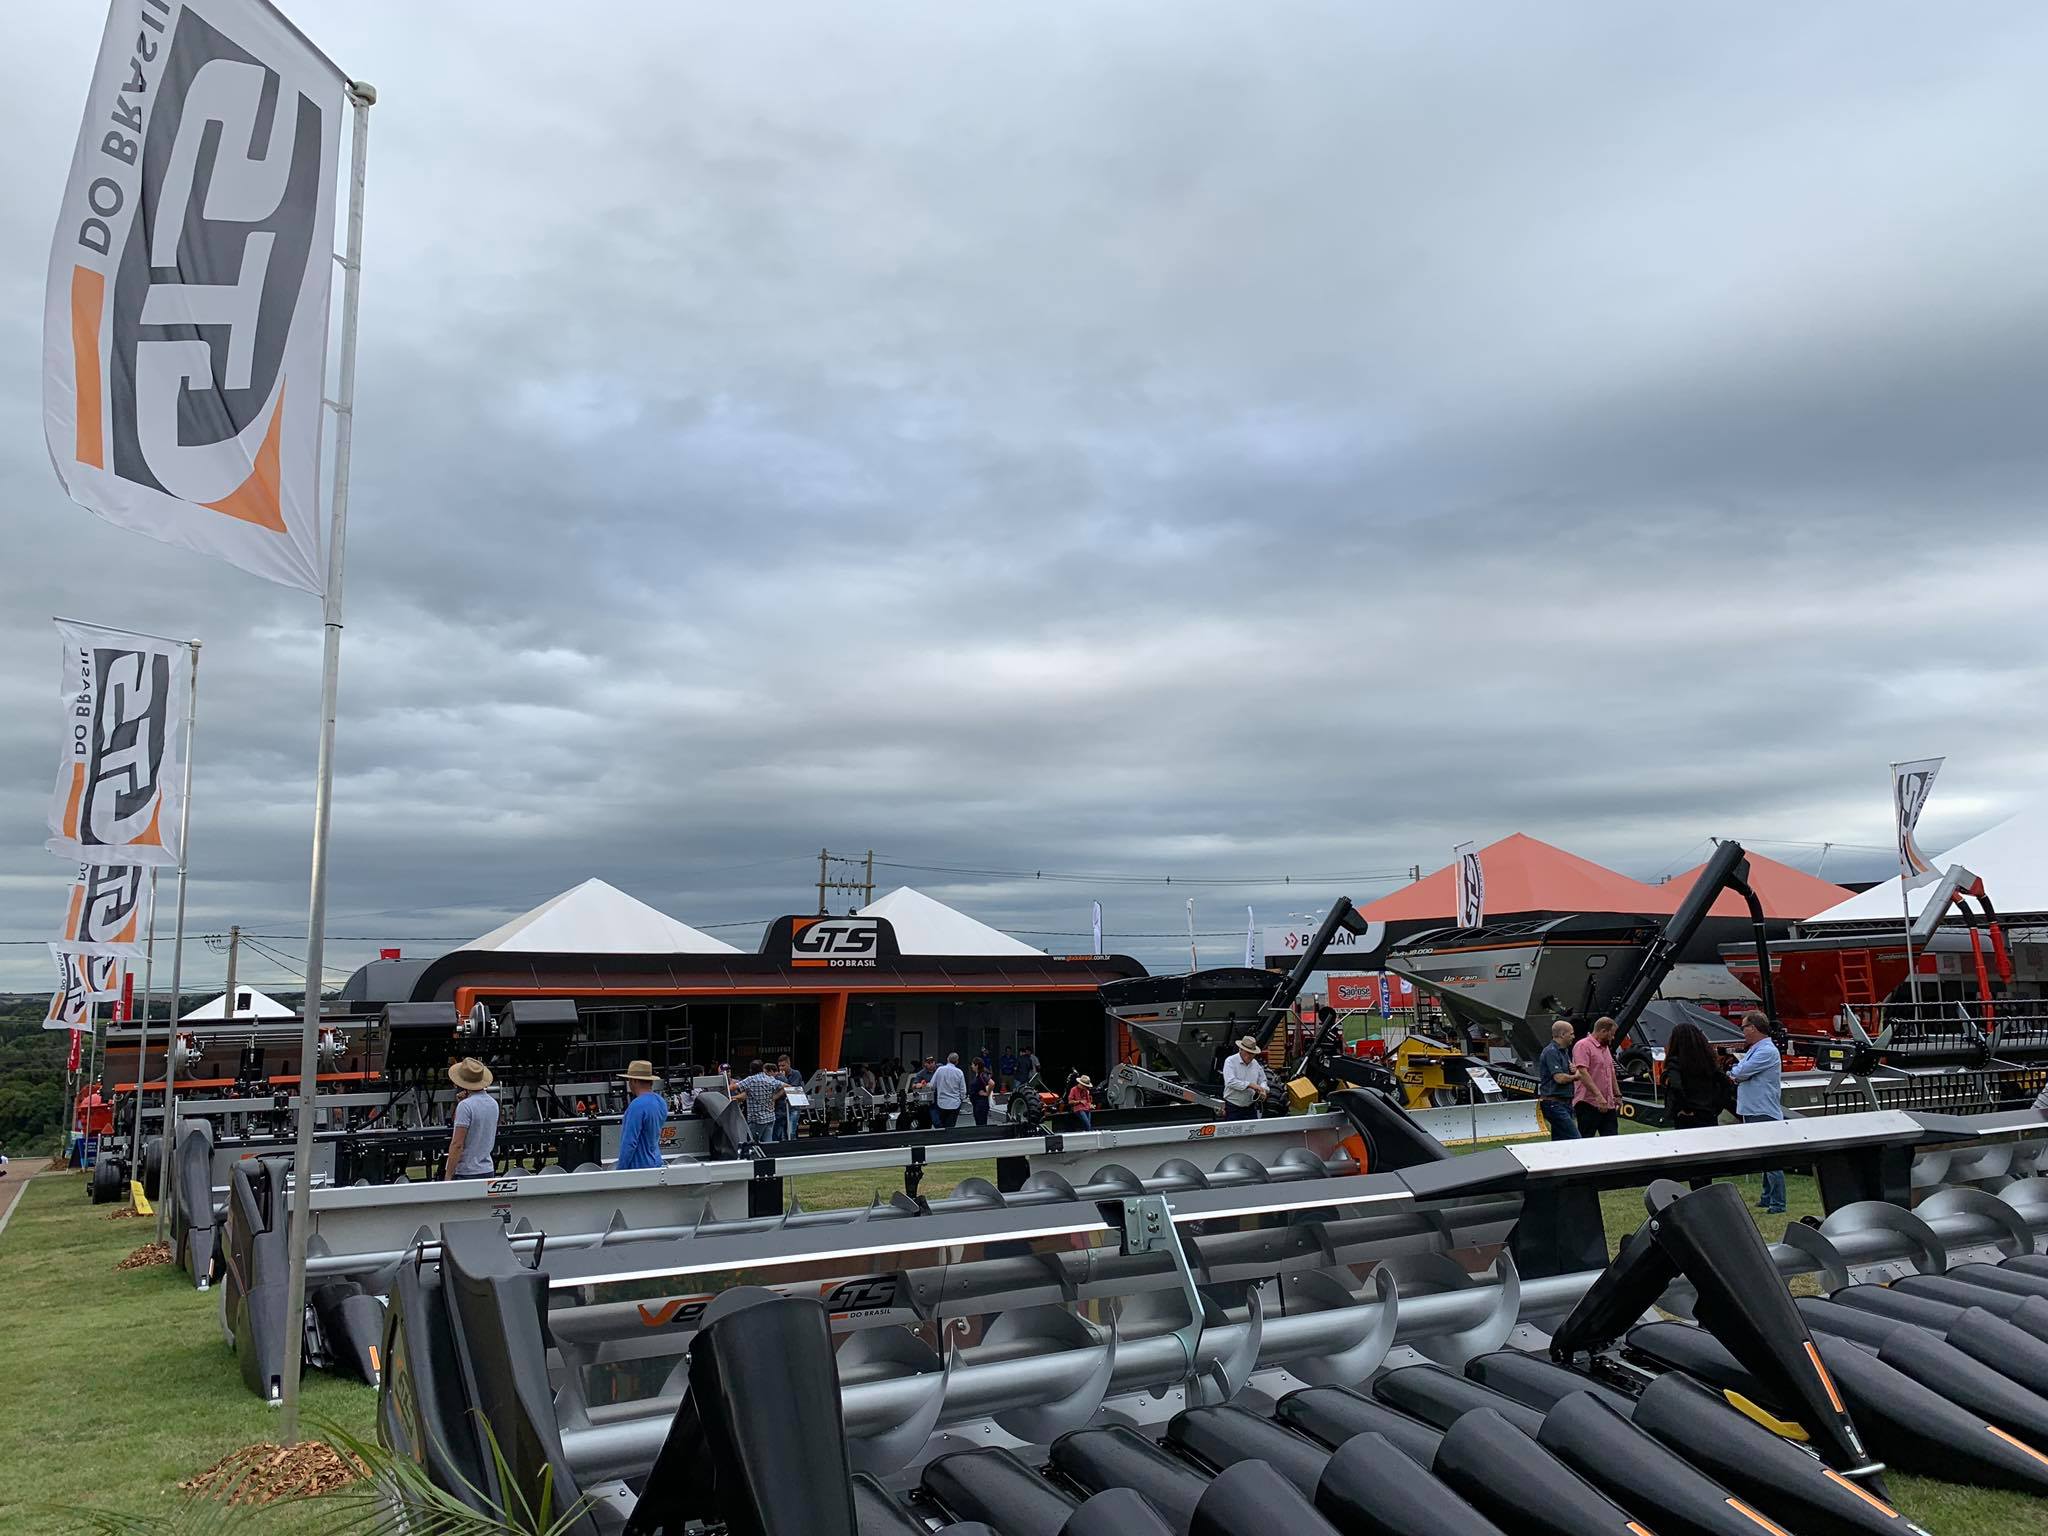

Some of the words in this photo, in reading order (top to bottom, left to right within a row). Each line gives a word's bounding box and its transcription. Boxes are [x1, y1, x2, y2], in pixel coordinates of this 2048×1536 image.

[793, 919, 877, 953] GTS
[1496, 963, 1521, 978] GTS
[1402, 1072, 1424, 1084] GTS
[488, 1179, 518, 1193] GTS
[823, 1276, 897, 1310] GTS
